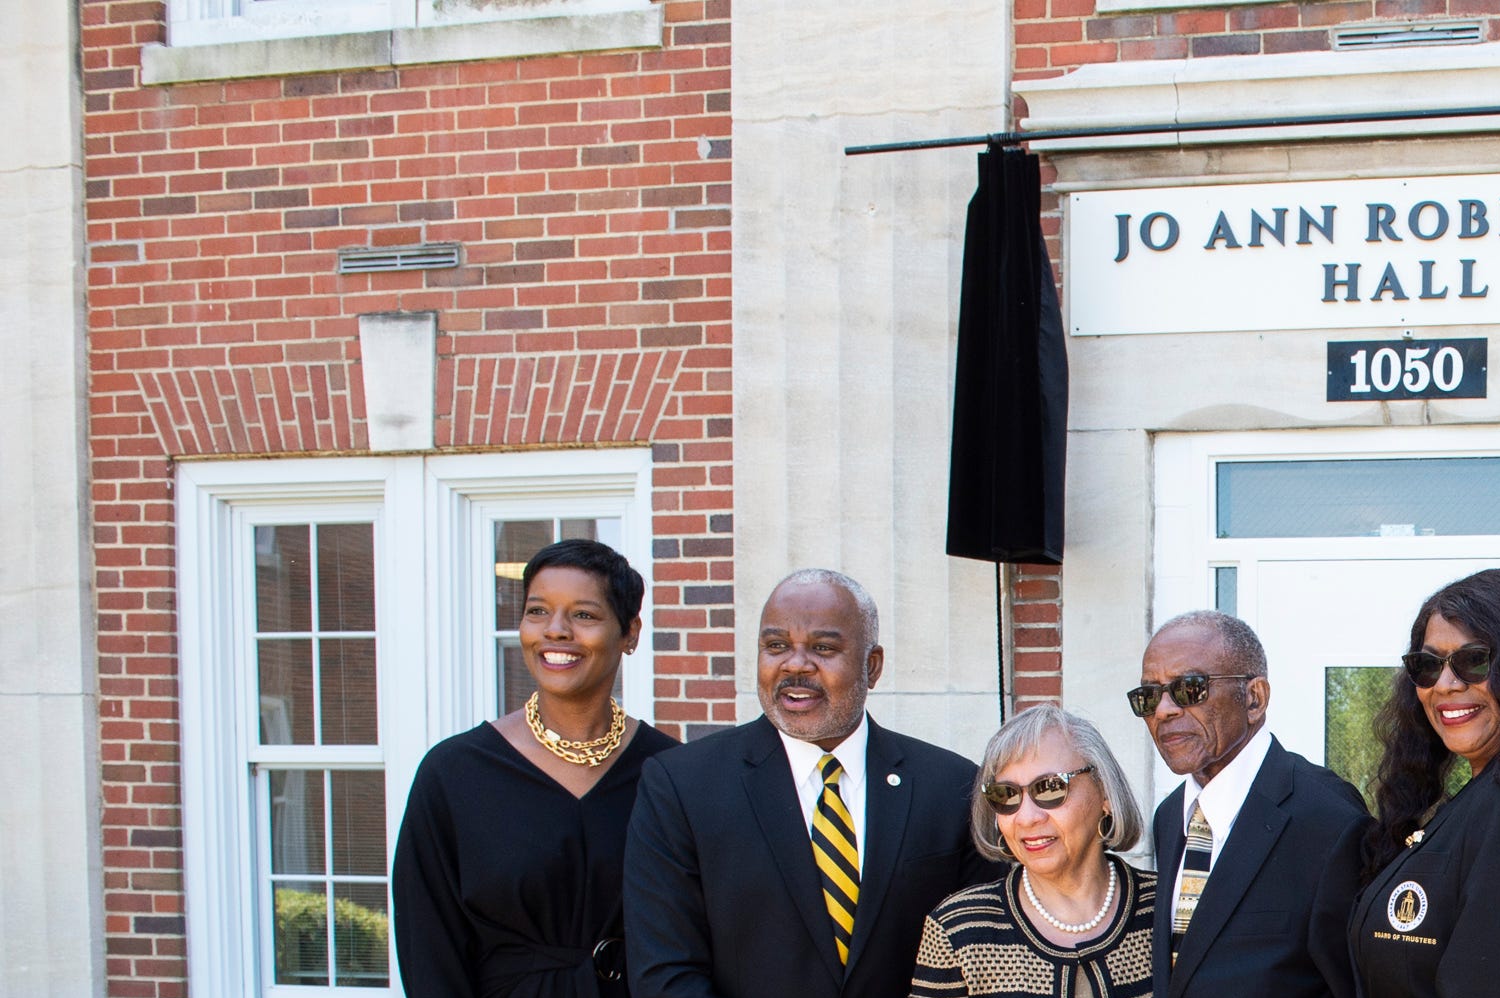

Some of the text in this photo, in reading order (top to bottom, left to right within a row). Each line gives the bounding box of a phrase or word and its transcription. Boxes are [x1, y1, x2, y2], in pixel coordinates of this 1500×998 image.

[1113, 211, 1180, 264] JO
[1203, 205, 1338, 251] ANN
[1321, 259, 1489, 303] HALL
[1350, 346, 1464, 393] 1050
[1374, 931, 1437, 945] BOARD OF TRUSTEES
